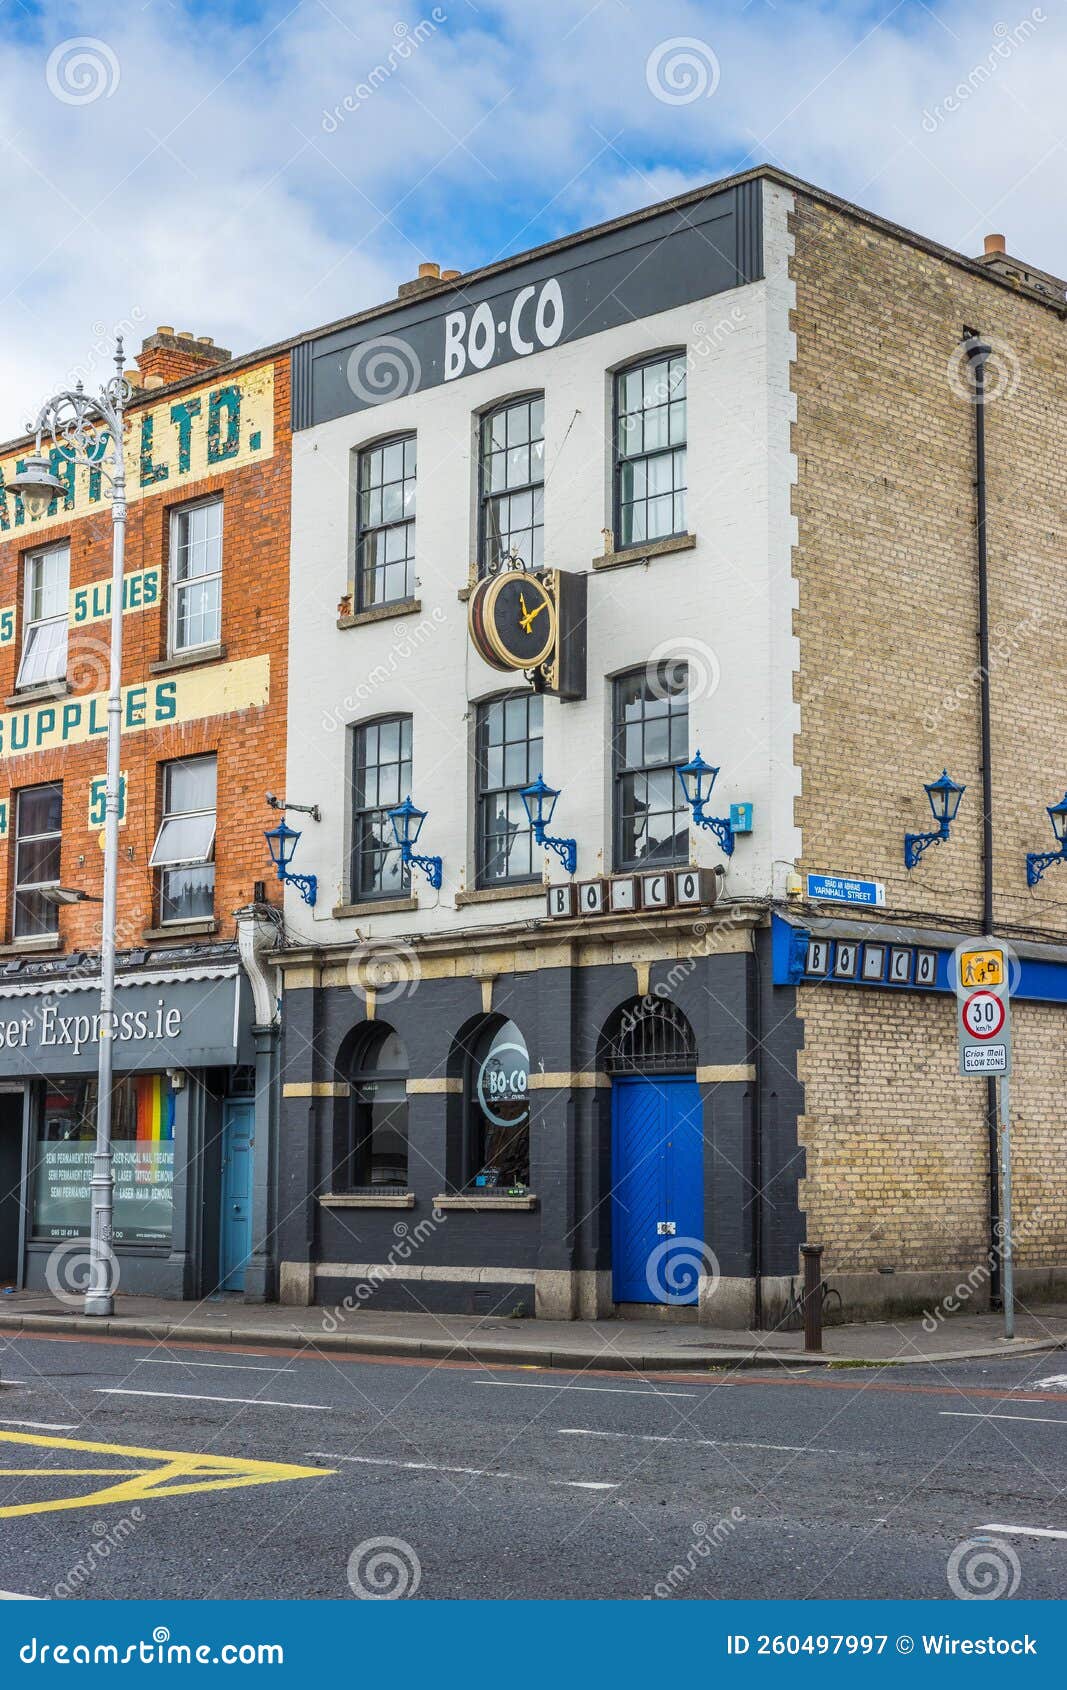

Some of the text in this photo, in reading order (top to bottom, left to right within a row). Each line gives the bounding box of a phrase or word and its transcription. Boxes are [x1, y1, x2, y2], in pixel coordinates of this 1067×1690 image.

[140, 385, 261, 487] LTD.
[75, 590, 87, 621] 5
[1, 611, 13, 641] 5
[0, 682, 176, 750] UPPLES
[814, 886, 872, 900] YARNHALL STREET
[973, 1003, 993, 1023] 30
[966, 1058, 1004, 1067] SLOW ZONE
[118, 1170, 132, 1181] LASER
[120, 1188, 133, 1199] LASER
